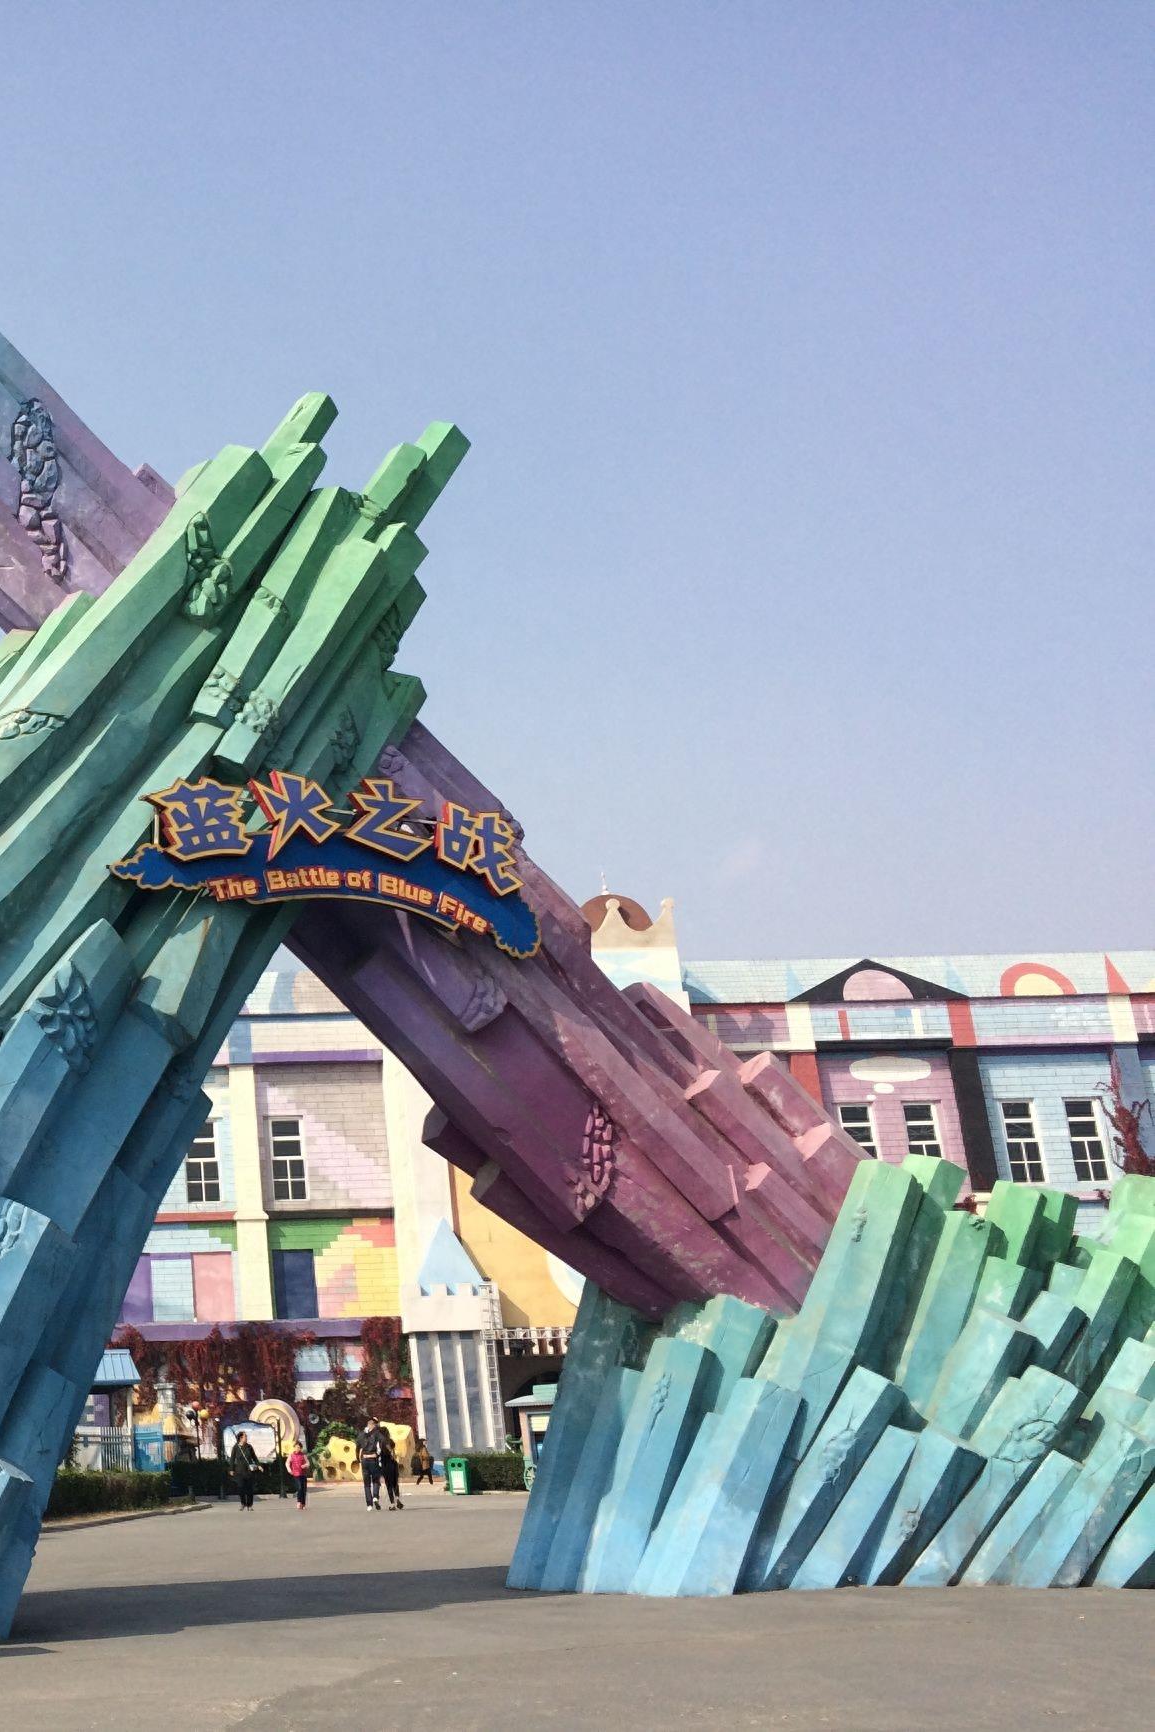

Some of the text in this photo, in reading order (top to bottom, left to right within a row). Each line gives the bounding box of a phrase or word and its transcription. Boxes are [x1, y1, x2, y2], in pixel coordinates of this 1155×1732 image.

[141, 770, 524, 897] 蓝火之战
[208, 867, 489, 934] The Battle of Blue Fire
